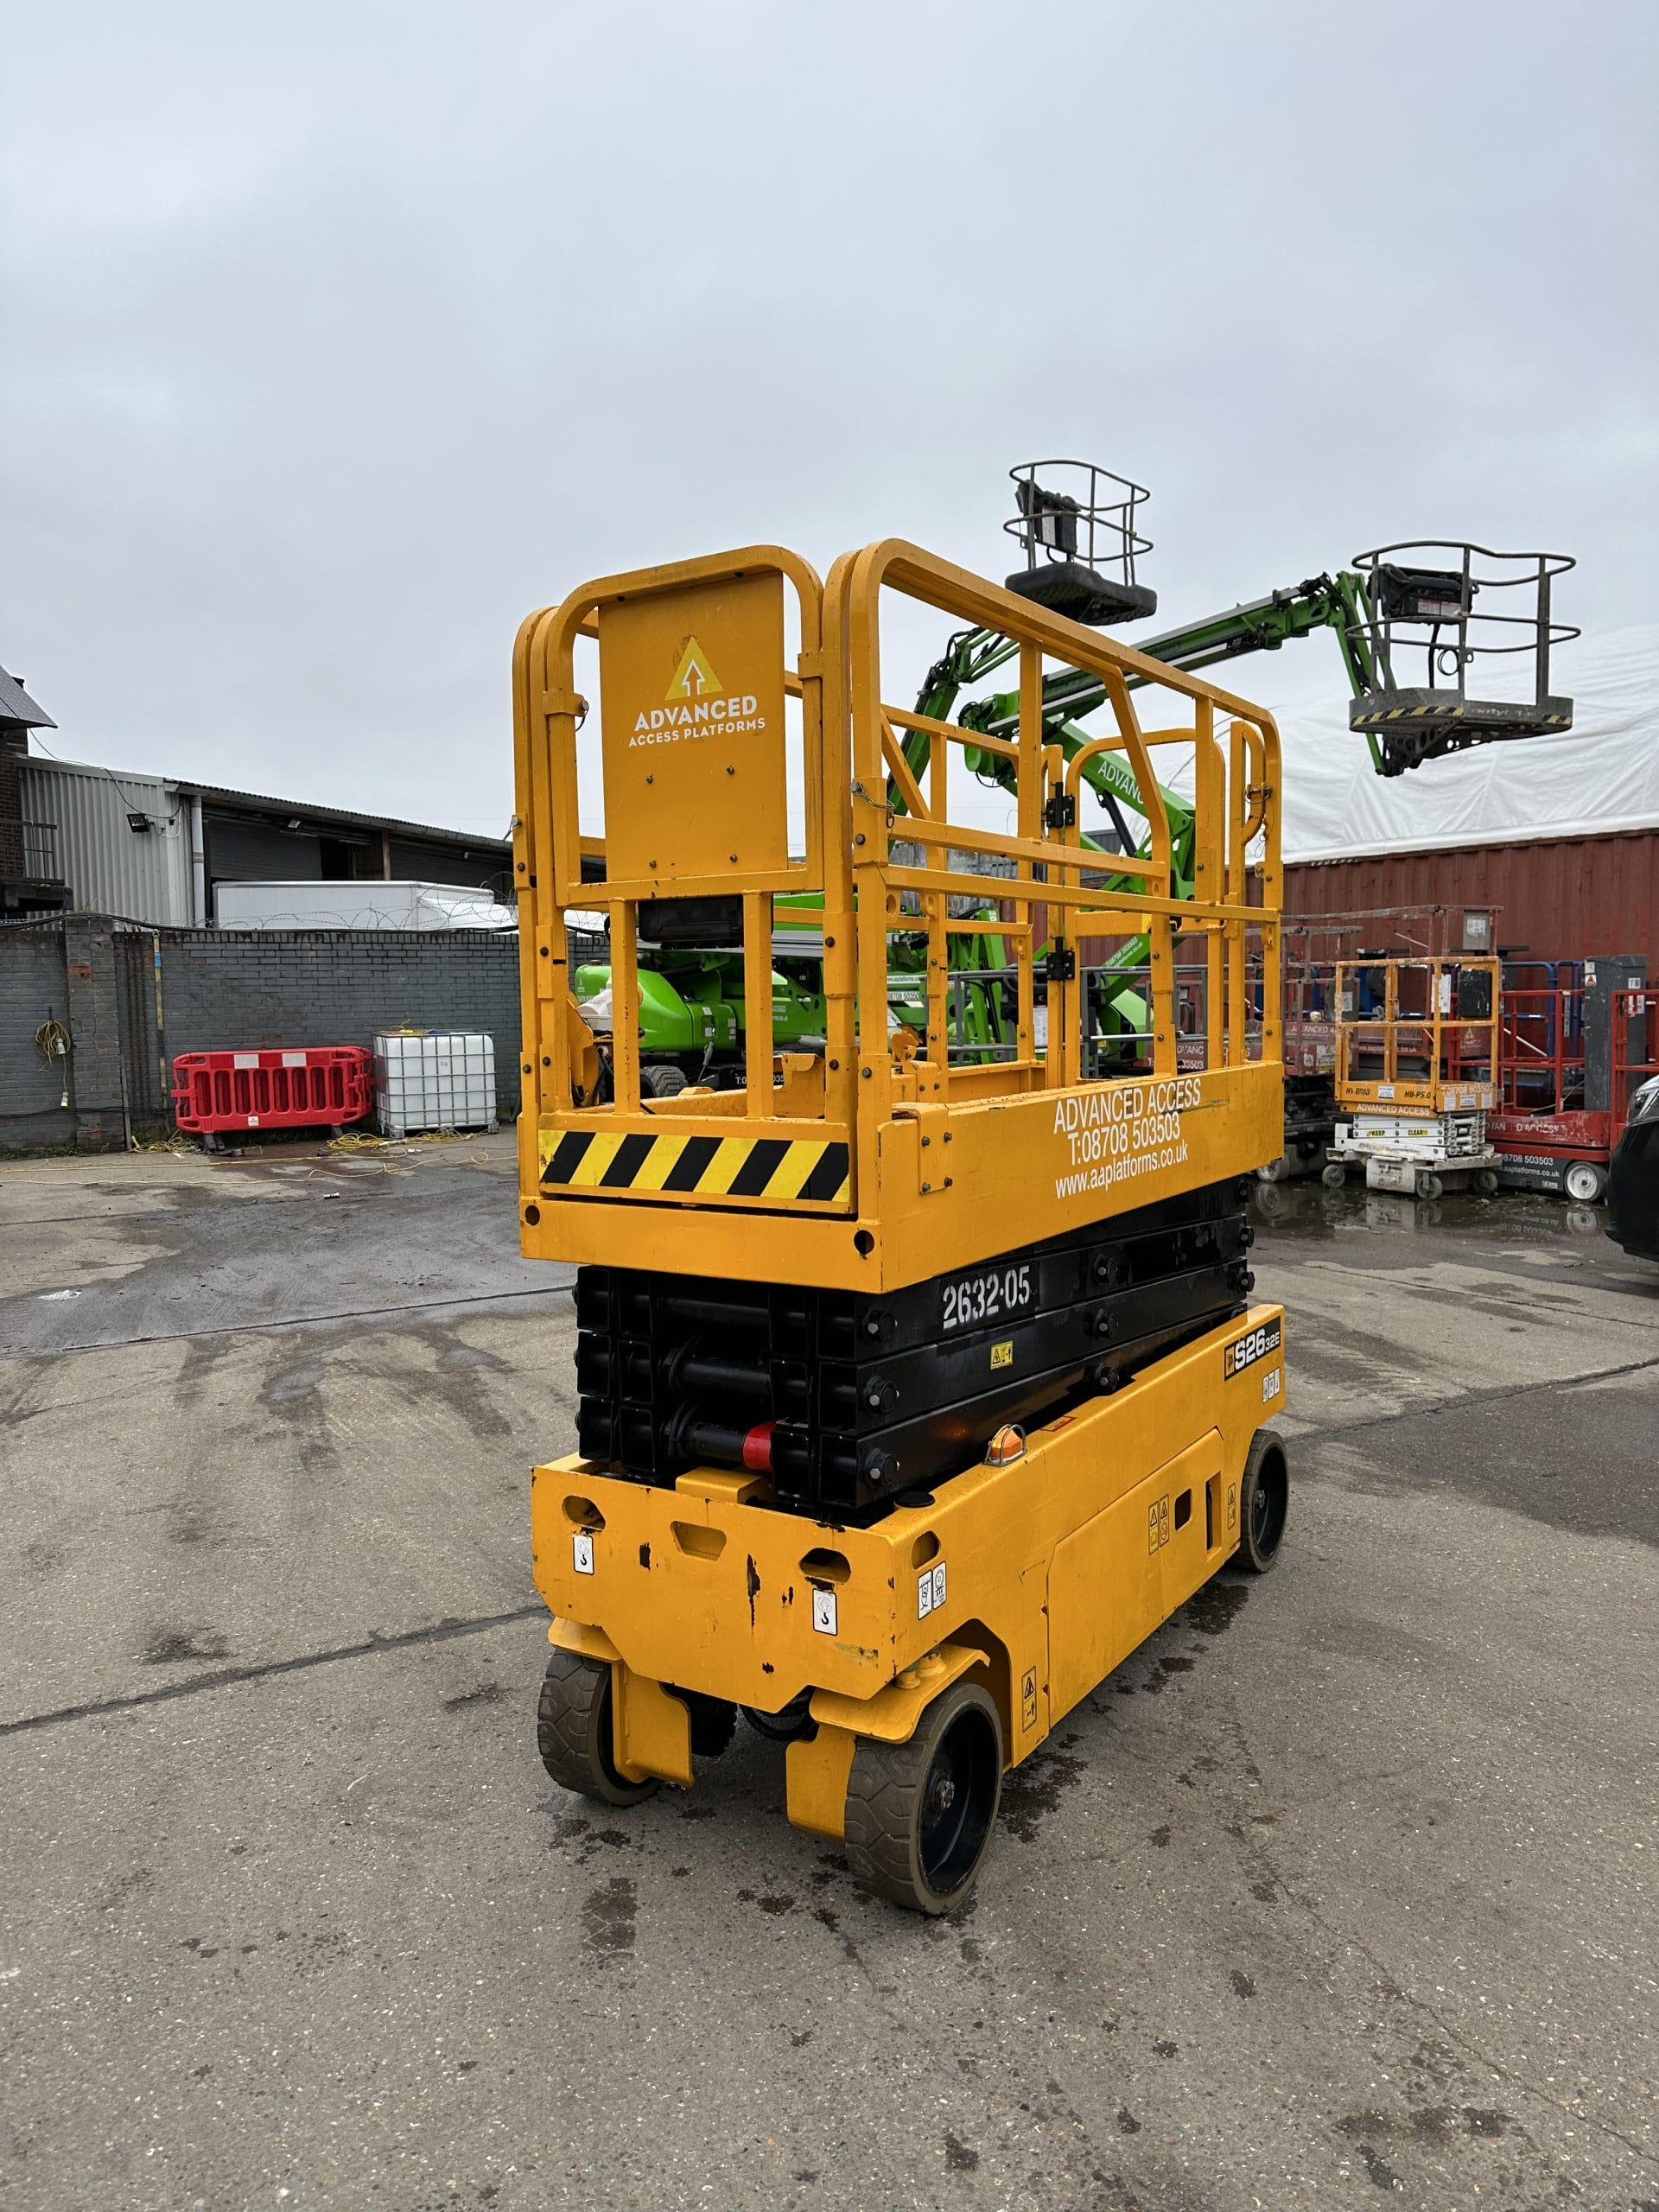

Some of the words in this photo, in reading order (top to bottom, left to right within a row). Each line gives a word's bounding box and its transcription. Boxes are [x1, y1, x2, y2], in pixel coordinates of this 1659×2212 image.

[628, 729, 680, 747] ACCESS
[683, 717, 766, 740] PLATFORMS
[634, 695, 758, 732] ADVANCED
[1053, 1087, 1144, 1135] ADVANCED
[1147, 1077, 1201, 1116] ACCESS
[1357, 1103, 1397, 1114] ADVANCED
[1397, 1106, 1430, 1116] ACCESS
[1067, 1122, 1128, 1166] T:08708
[1132, 1111, 1180, 1150] 503503
[1055, 1139, 1188, 1199] www.aaplatforms.co.uk
[1503, 1153, 1522, 1163] 8708
[1524, 1155, 1554, 1166] 503503
